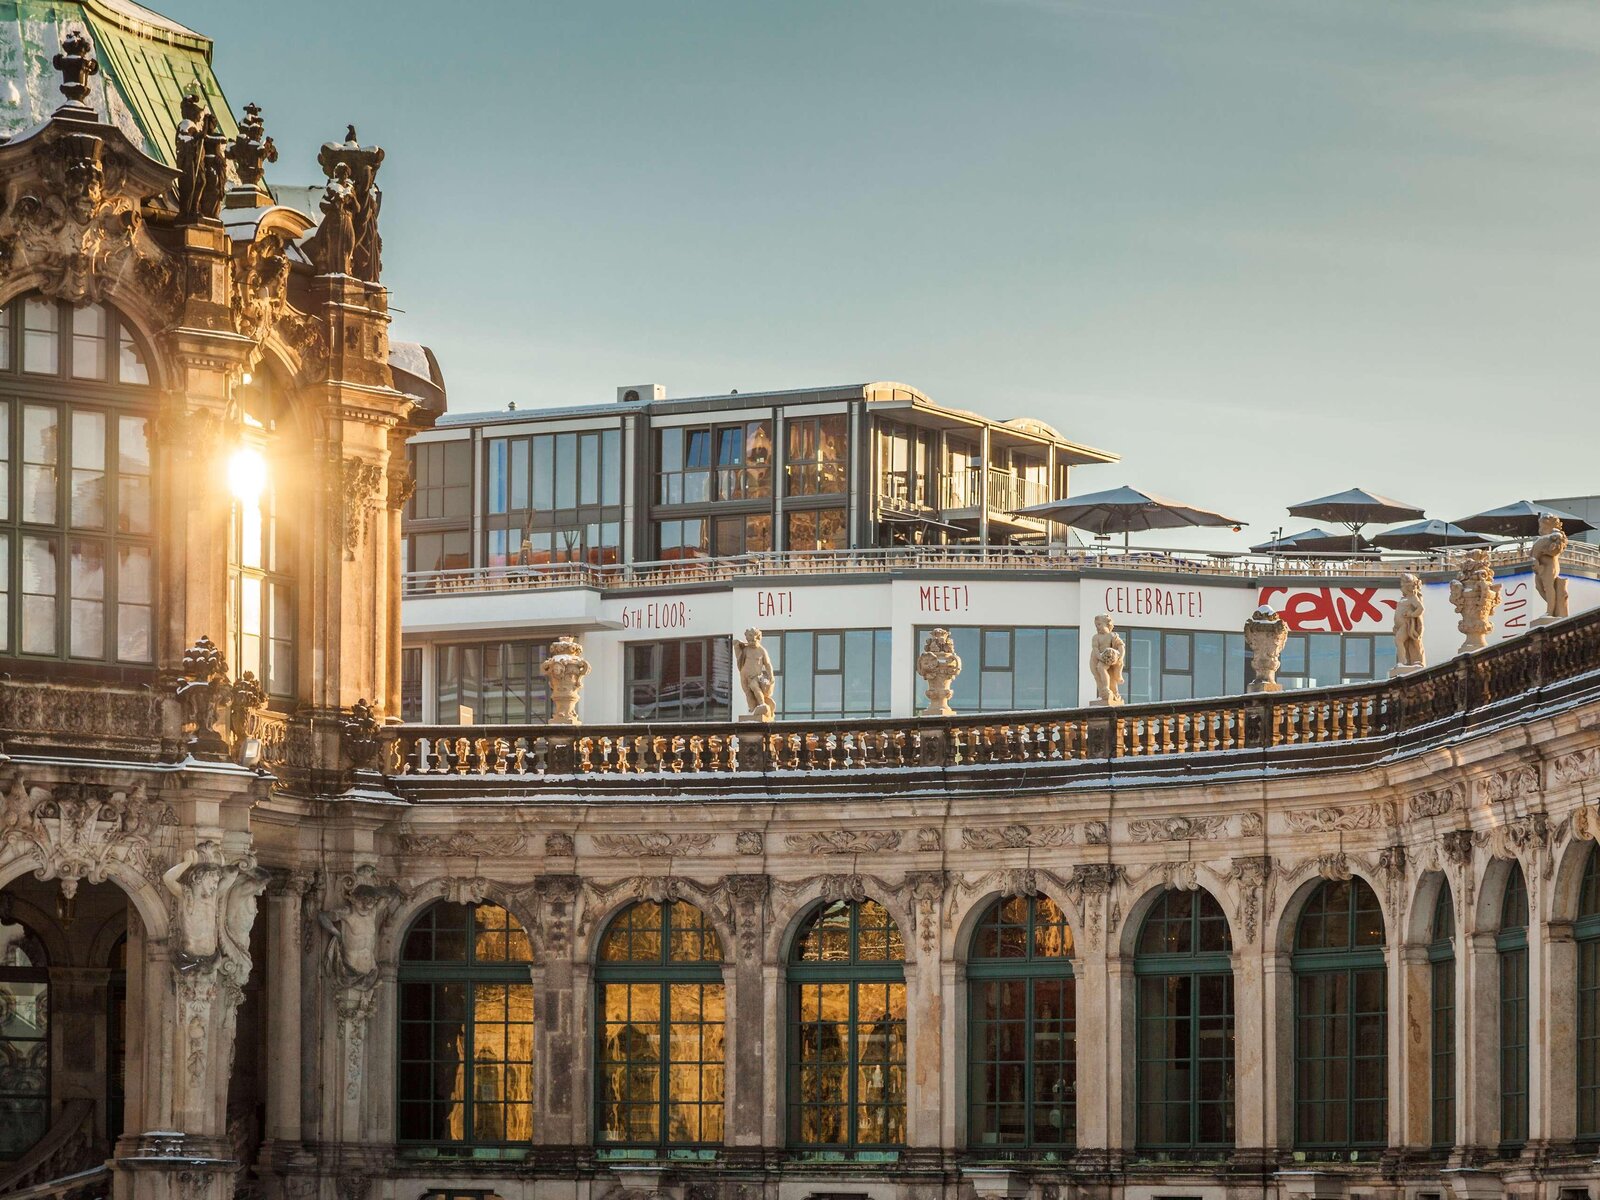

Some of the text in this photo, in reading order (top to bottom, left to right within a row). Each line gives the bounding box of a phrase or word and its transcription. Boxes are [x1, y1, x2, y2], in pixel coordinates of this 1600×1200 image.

[757, 591, 793, 618] EAT!
[919, 585, 969, 612] MEET!
[1105, 586, 1203, 618] CELEBRATE!
[1502, 582, 1528, 639] AUS
[622, 601, 692, 629] 6TH FLOOR:
